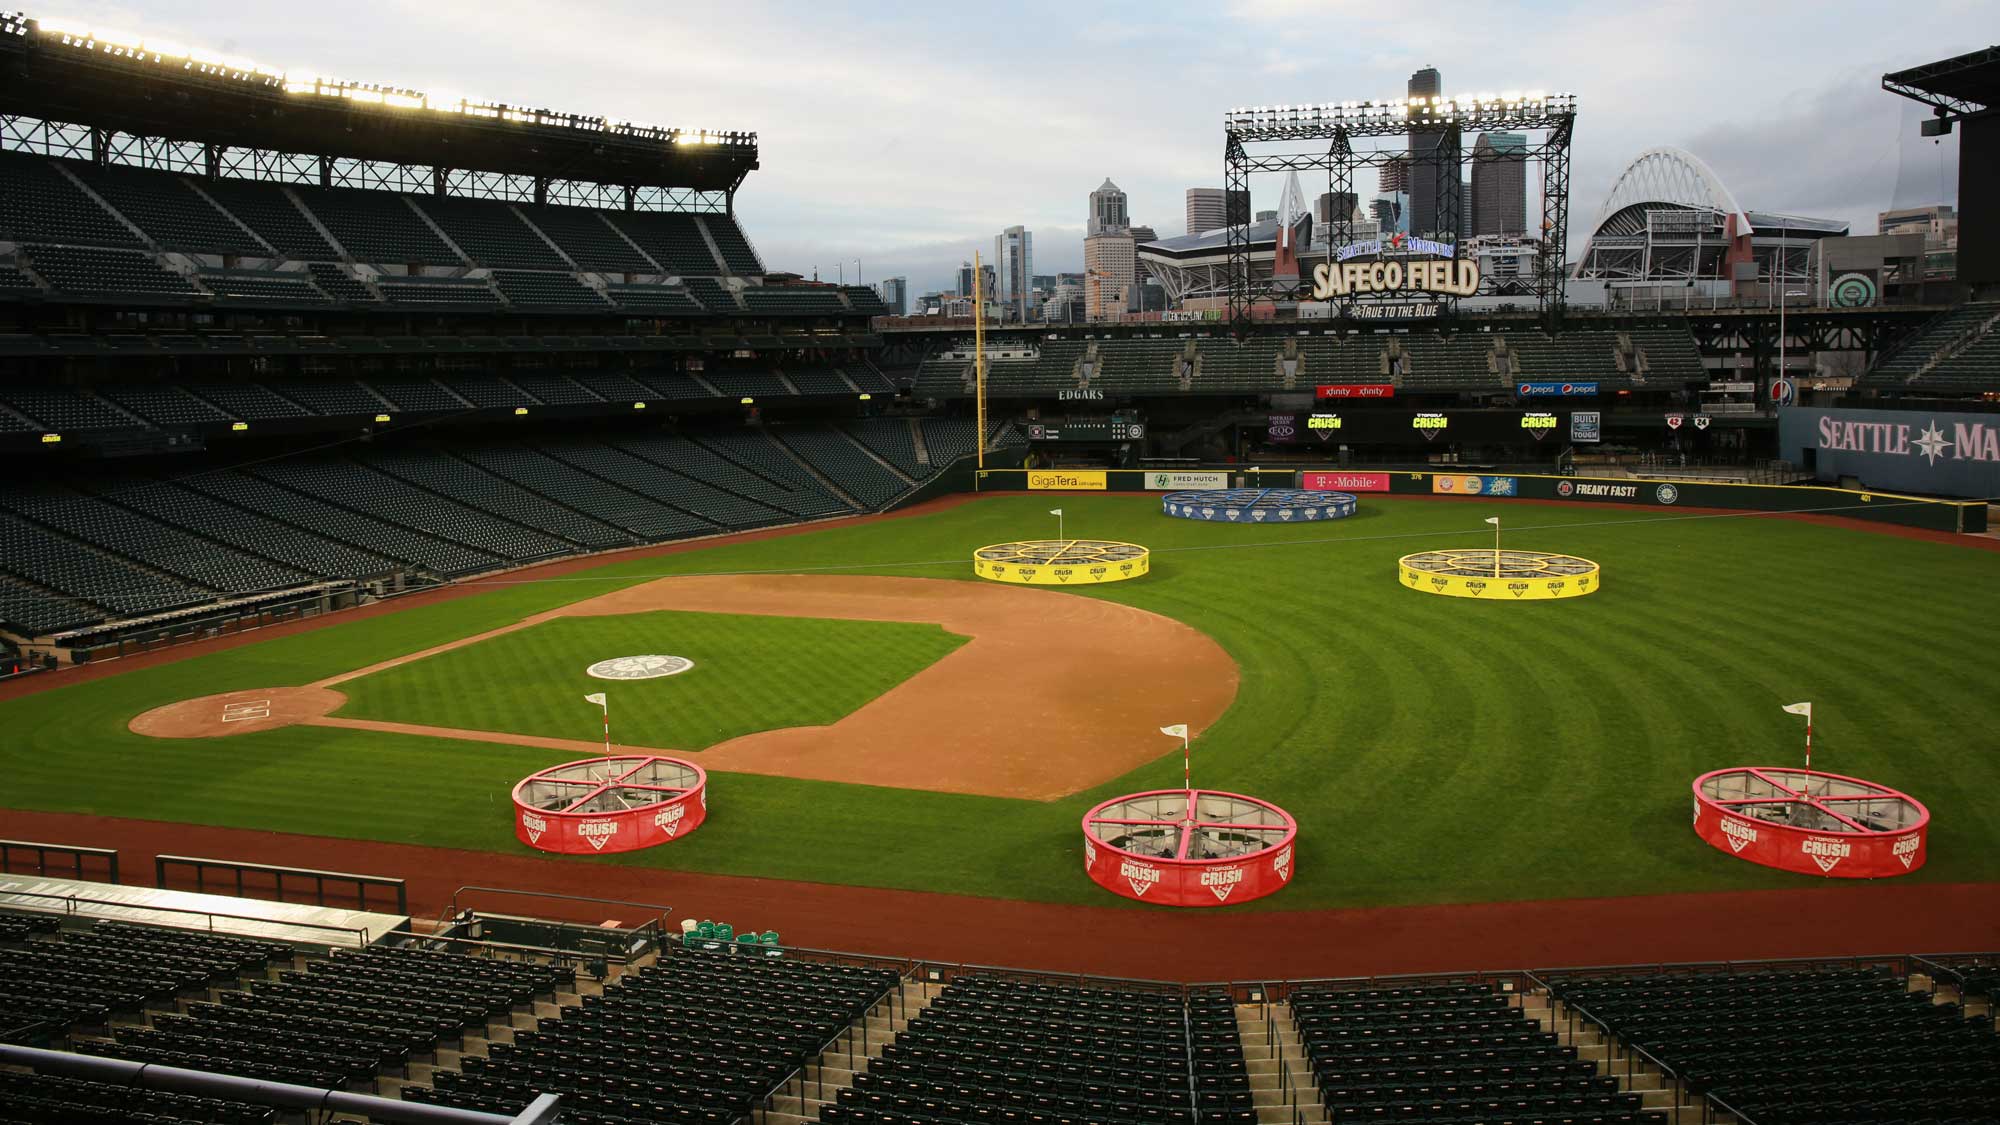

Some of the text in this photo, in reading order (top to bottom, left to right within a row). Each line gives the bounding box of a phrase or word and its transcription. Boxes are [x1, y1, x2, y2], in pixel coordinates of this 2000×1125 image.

[1408, 237, 1454, 258] MARINERS
[1313, 259, 1480, 300] SAFECO FIELD
[1361, 303, 1439, 318] TRUE TO THE BLUE
[1058, 389, 1104, 400] EDGARS
[1326, 386, 1384, 397] xfinity xfinity
[1532, 384, 1596, 393] pepsi pepsi
[1308, 418, 1342, 428] CRUSH
[1413, 417, 1448, 428] CRUSH
[1521, 417, 1557, 428] CRUSH
[1574, 415, 1597, 423] BUILT
[1574, 431, 1597, 439] TOUGH
[1819, 416, 1911, 454] SEATTLE
[1031, 474, 1077, 488] GigaTera
[1576, 484, 1609, 495] FREAKY
[1610, 485, 1636, 497] FAST!
[1431, 577, 1448, 586] CRUSH
[1466, 581, 1486, 589] CRUSH
[654, 805, 684, 826] CRUSH
[1729, 817, 1751, 827] TOPGOLF
[523, 814, 546, 832] CRUSH
[578, 822, 618, 835] CRUSH
[1720, 819, 1757, 842] CRUSH
[1802, 841, 1850, 857] CRUSH
[1892, 837, 1920, 855] CRUSH
[1129, 860, 1153, 868] TOPGOLF
[1120, 862, 1160, 882] CRUSH
[1200, 869, 1242, 886] CRUSH
